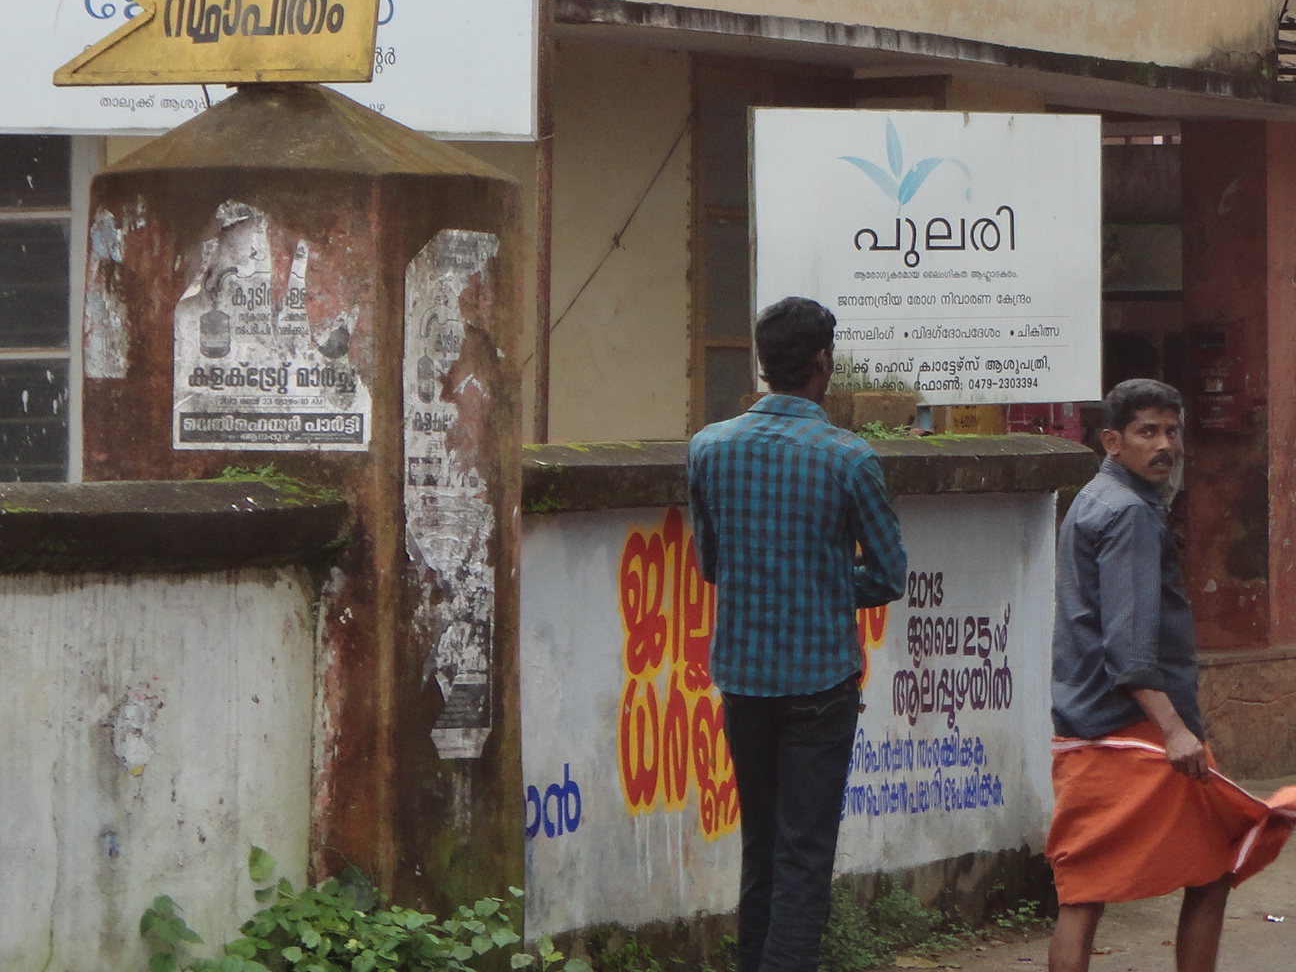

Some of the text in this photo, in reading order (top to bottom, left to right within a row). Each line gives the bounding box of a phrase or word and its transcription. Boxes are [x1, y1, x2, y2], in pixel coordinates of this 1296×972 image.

[853, 204, 1016, 268] പുലരി
[837, 292, 1031, 308] ജനനേന്ദ്രിയ രോഗ നിവാരണ കേന്ദ്രം
[834, 326, 895, 341] ൺസലിംഗ്
[1017, 324, 1060, 338] ചികിത്സ
[875, 357, 914, 374] ഹെഡ്
[968, 377, 1039, 391] 0479-2303394
[304, 414, 361, 435] പാർട്ടി
[907, 570, 944, 609] 2013
